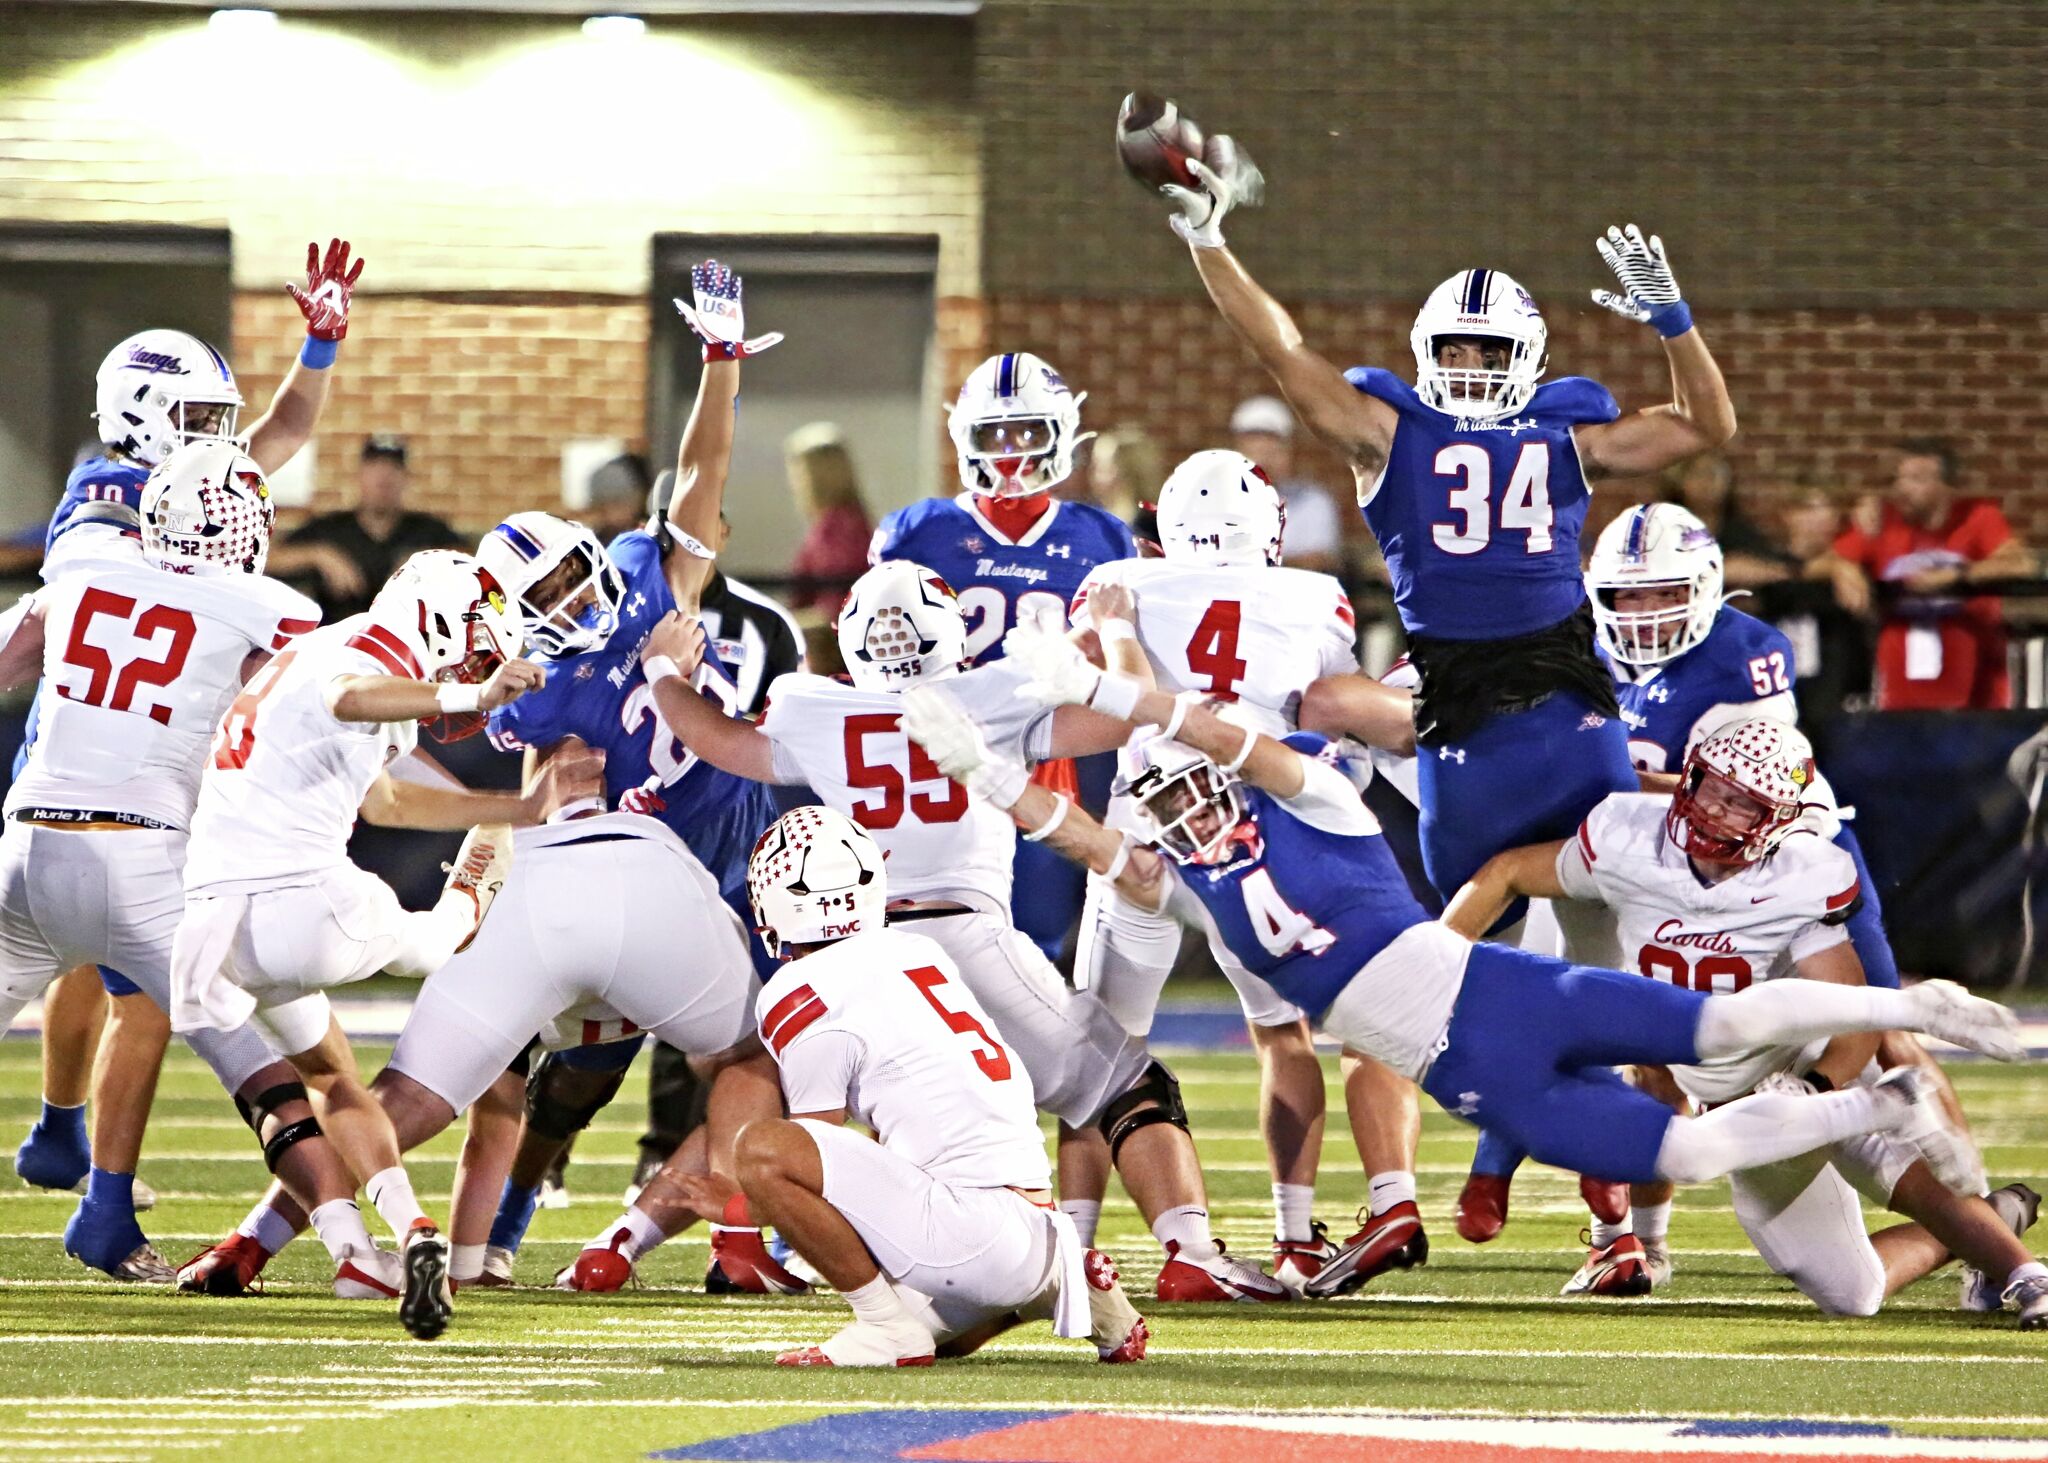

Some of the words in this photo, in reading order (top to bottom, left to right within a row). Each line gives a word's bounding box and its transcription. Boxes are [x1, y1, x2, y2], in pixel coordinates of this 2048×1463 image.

[703, 299, 737, 320] USA
[1431, 442, 1554, 556] 34
[180, 540, 200, 556] 52
[975, 558, 1048, 585] Mustangs
[56, 586, 197, 728] 52
[955, 586, 1067, 662] 2
[1186, 600, 1247, 704] 4
[899, 659, 922, 678] 55
[1747, 650, 1790, 698] 52
[203, 650, 298, 770] 8
[844, 713, 969, 831] 55
[115, 811, 169, 830] Hurley
[1240, 866, 1337, 957] 4
[1654, 918, 1738, 954] Cards
[903, 966, 1012, 1082] 5
